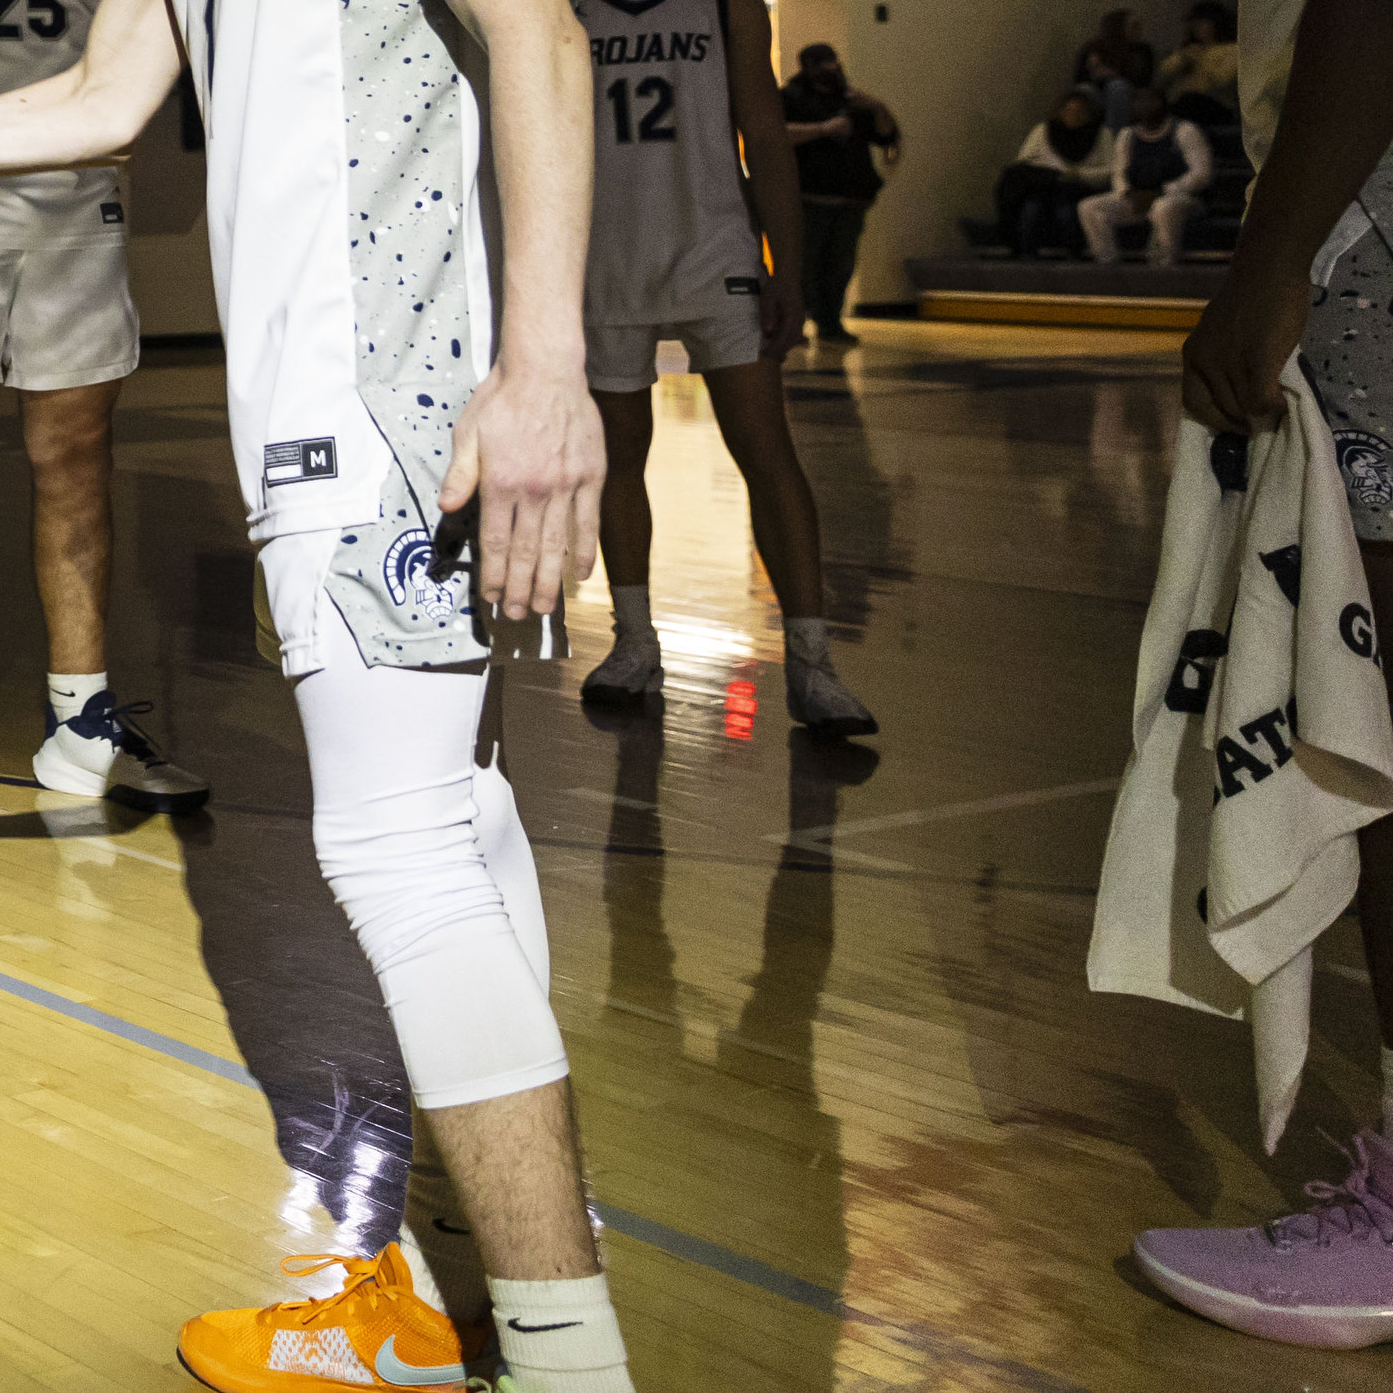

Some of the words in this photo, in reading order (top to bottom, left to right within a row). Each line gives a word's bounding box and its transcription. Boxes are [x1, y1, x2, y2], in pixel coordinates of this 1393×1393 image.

[589, 32, 712, 65] ROJANS
[607, 77, 676, 144] 12
[310, 450, 327, 468] M
